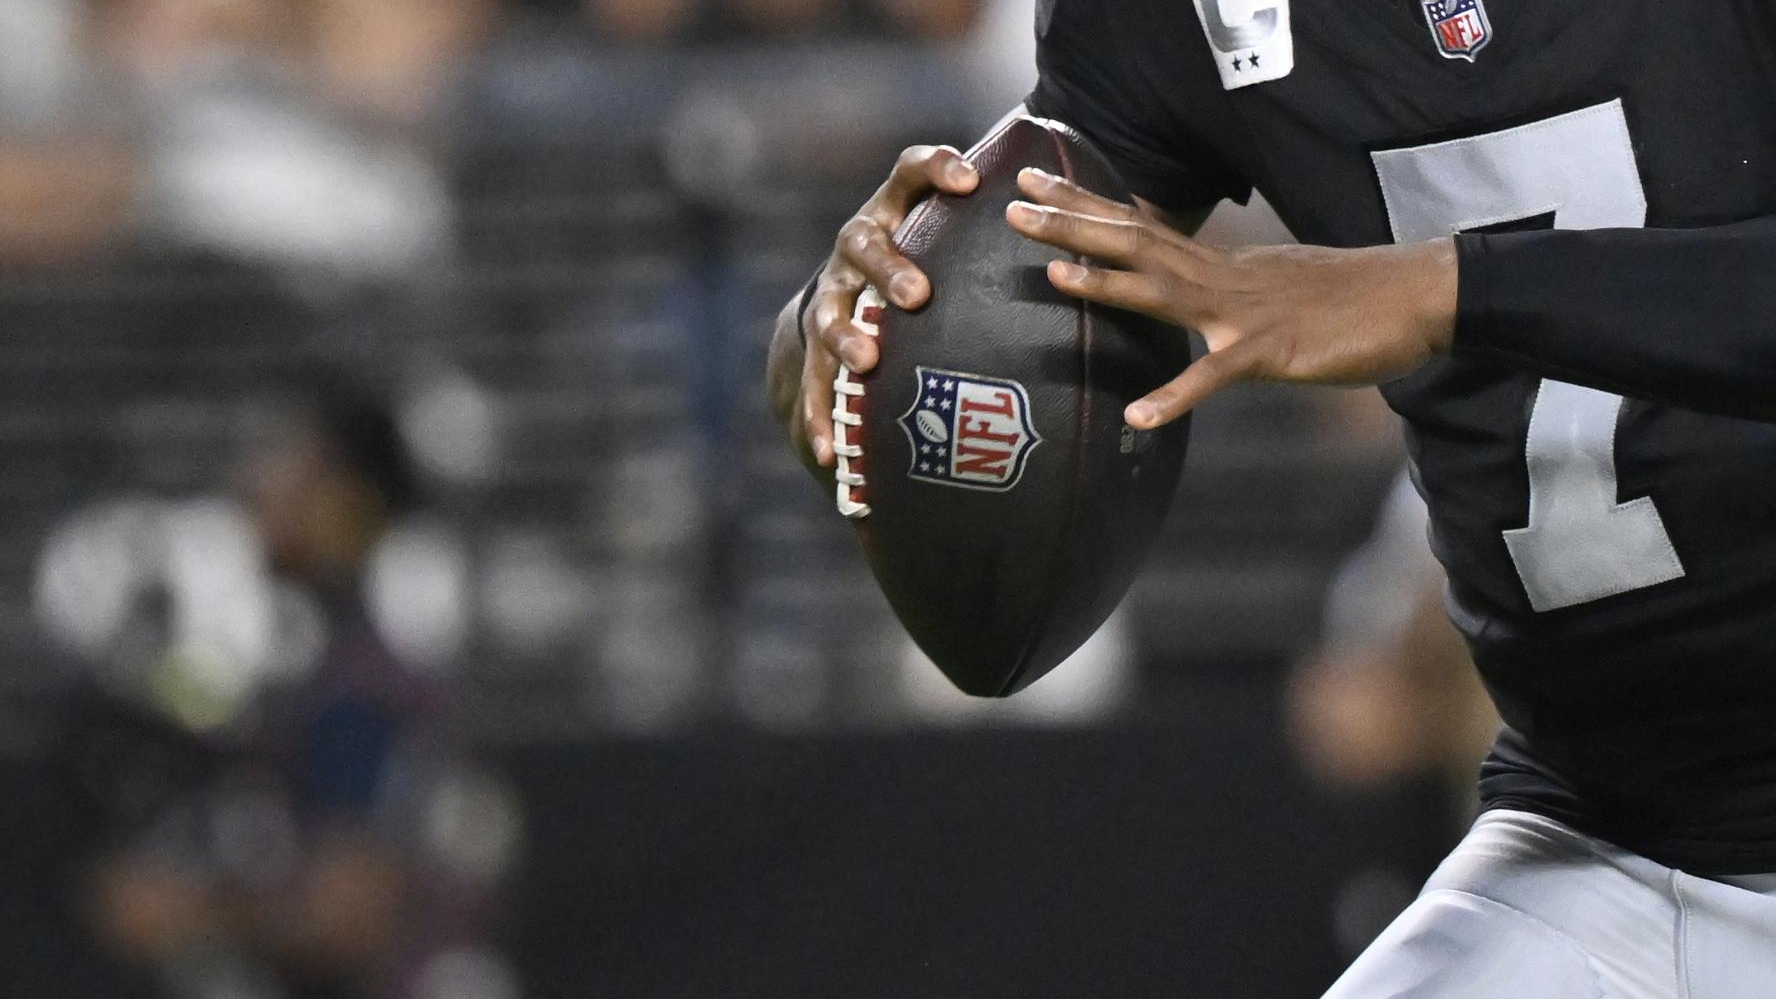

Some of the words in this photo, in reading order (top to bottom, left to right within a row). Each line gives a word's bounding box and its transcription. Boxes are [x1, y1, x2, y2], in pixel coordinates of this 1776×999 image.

[1438, 14, 1482, 49] NFL
[1369, 98, 1686, 613] 7
[955, 392, 1021, 480] NFL
